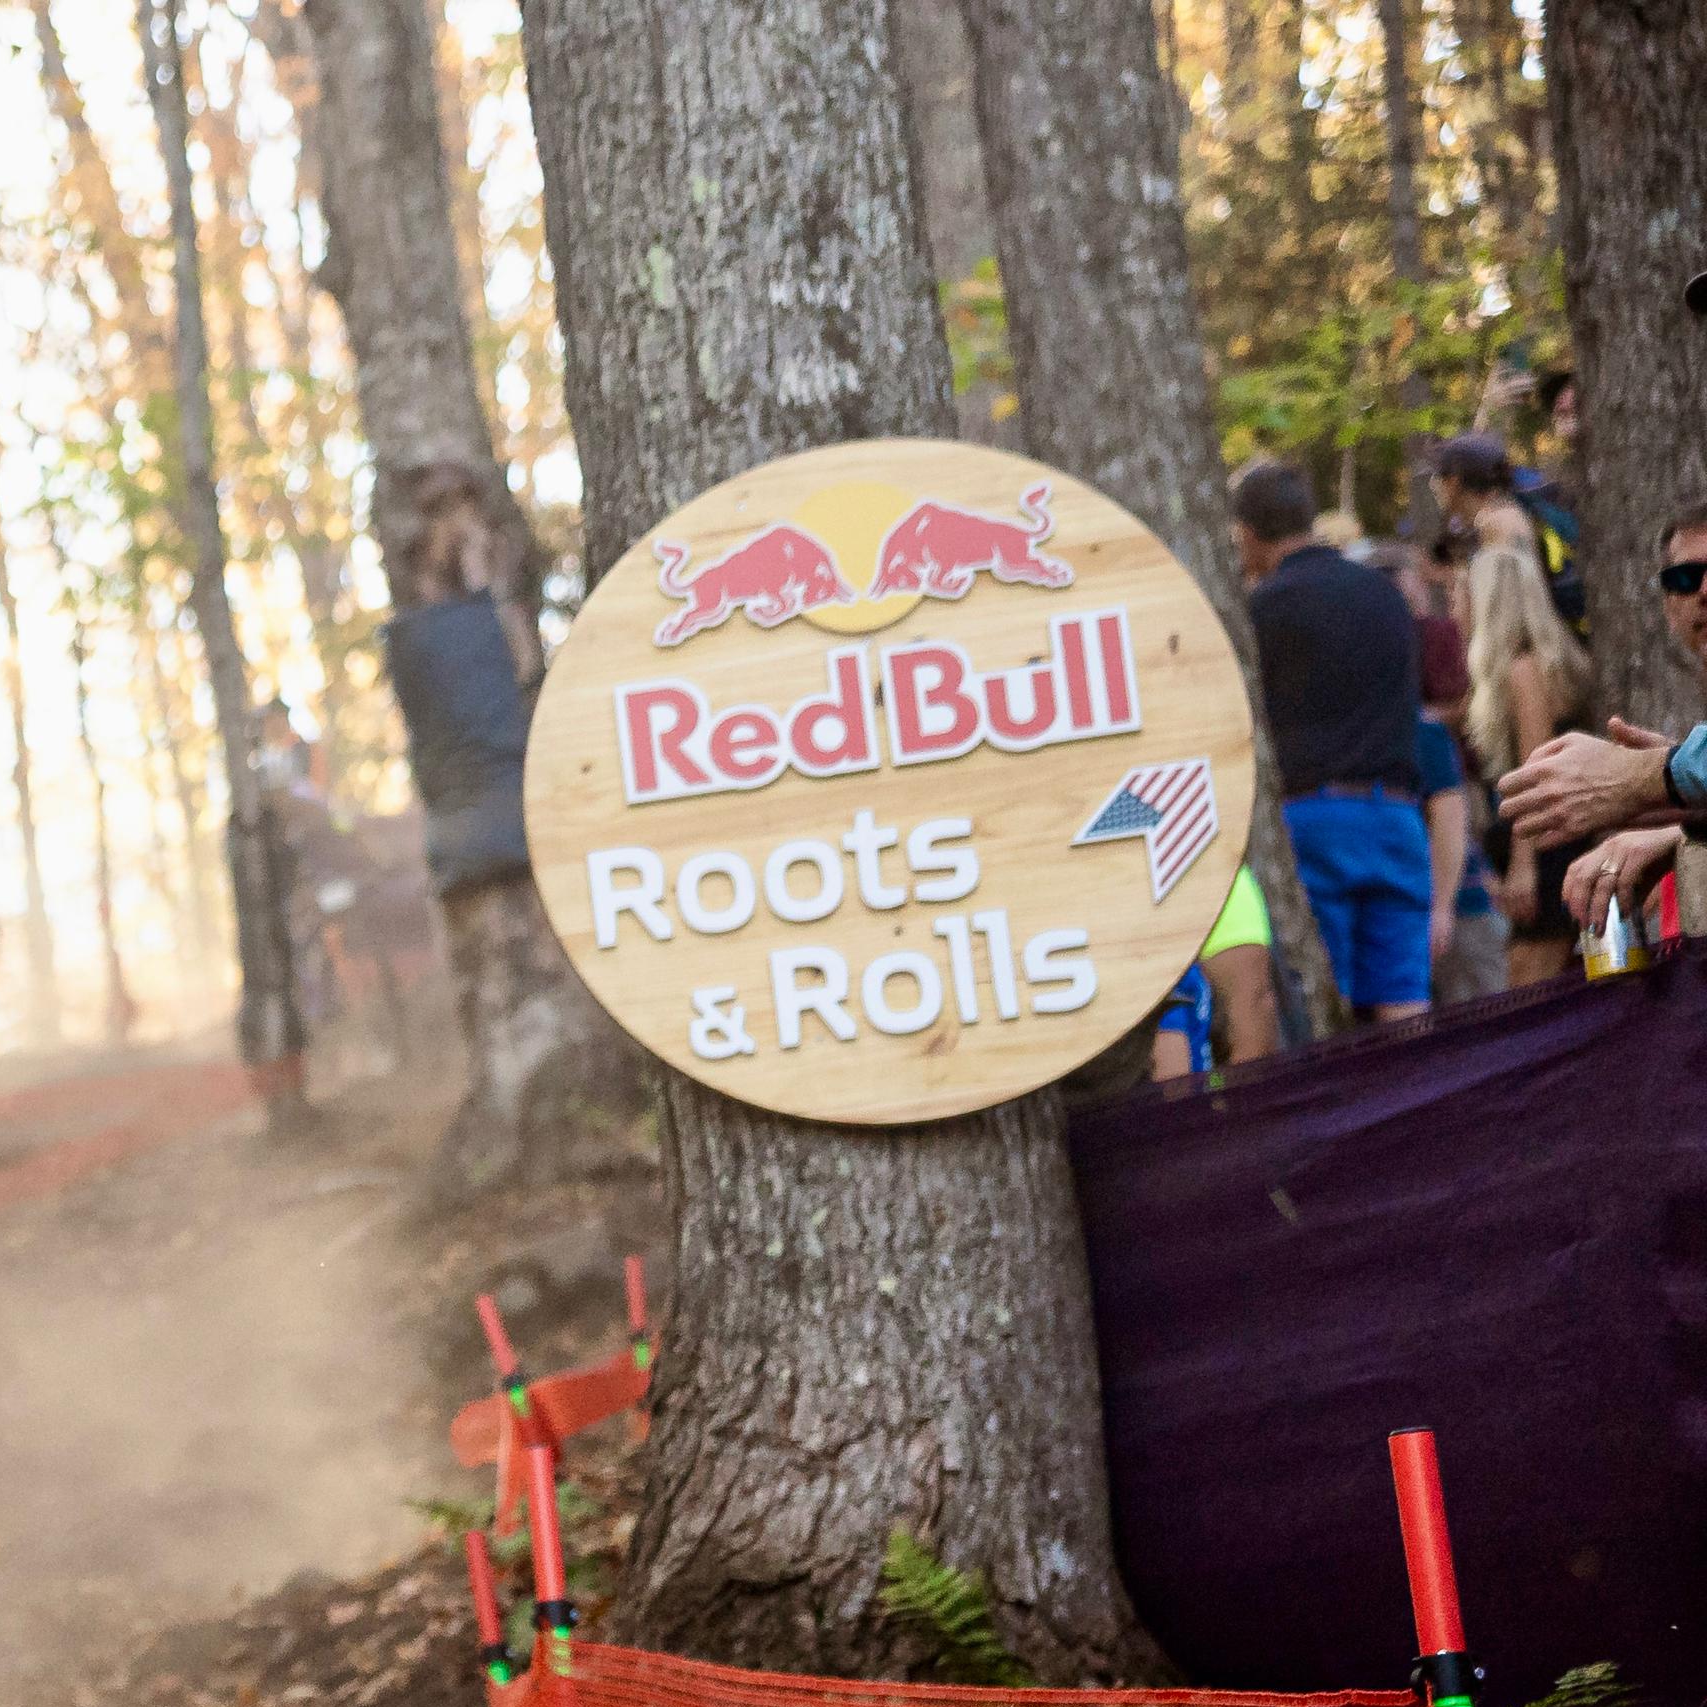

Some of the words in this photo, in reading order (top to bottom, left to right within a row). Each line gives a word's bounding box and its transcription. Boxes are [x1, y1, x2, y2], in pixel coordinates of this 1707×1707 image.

[620, 649, 872, 798] Red
[886, 612, 1136, 774] Bull
[587, 808, 982, 951] Roots
[689, 985, 756, 1060] &
[769, 908, 1098, 1050] Rolls
